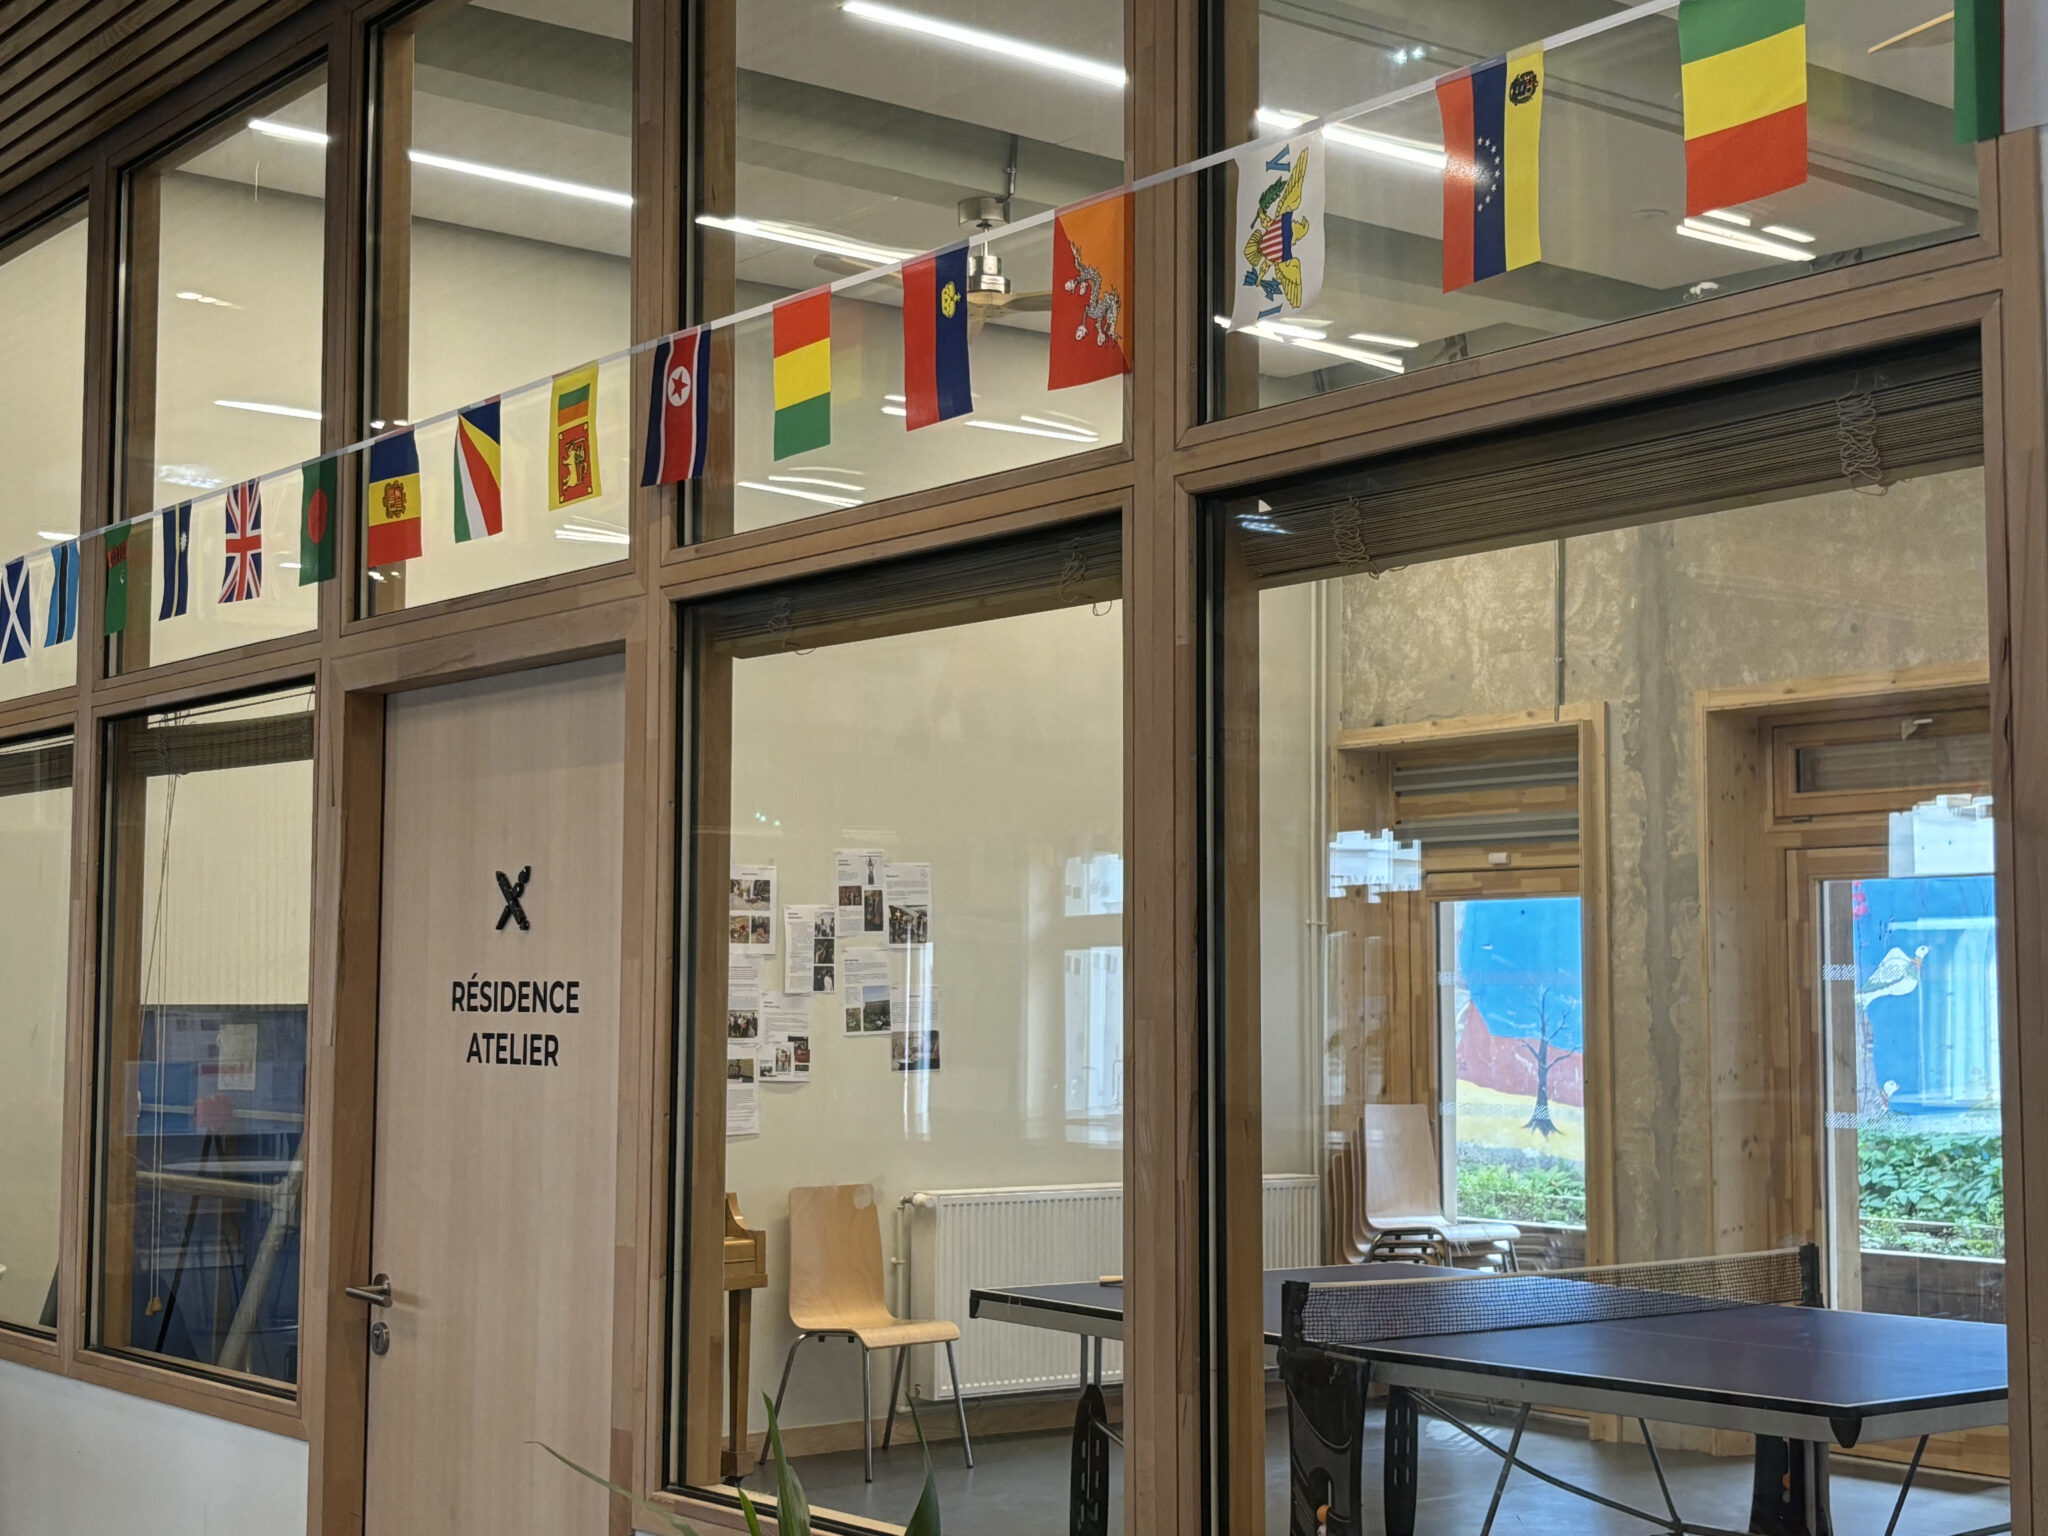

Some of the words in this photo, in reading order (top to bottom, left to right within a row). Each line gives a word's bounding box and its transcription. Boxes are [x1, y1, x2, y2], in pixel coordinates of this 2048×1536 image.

[1266, 144, 1291, 173] V
[451, 972, 580, 1014] RÉSIDENCE
[466, 1032, 560, 1067] ATELIER
